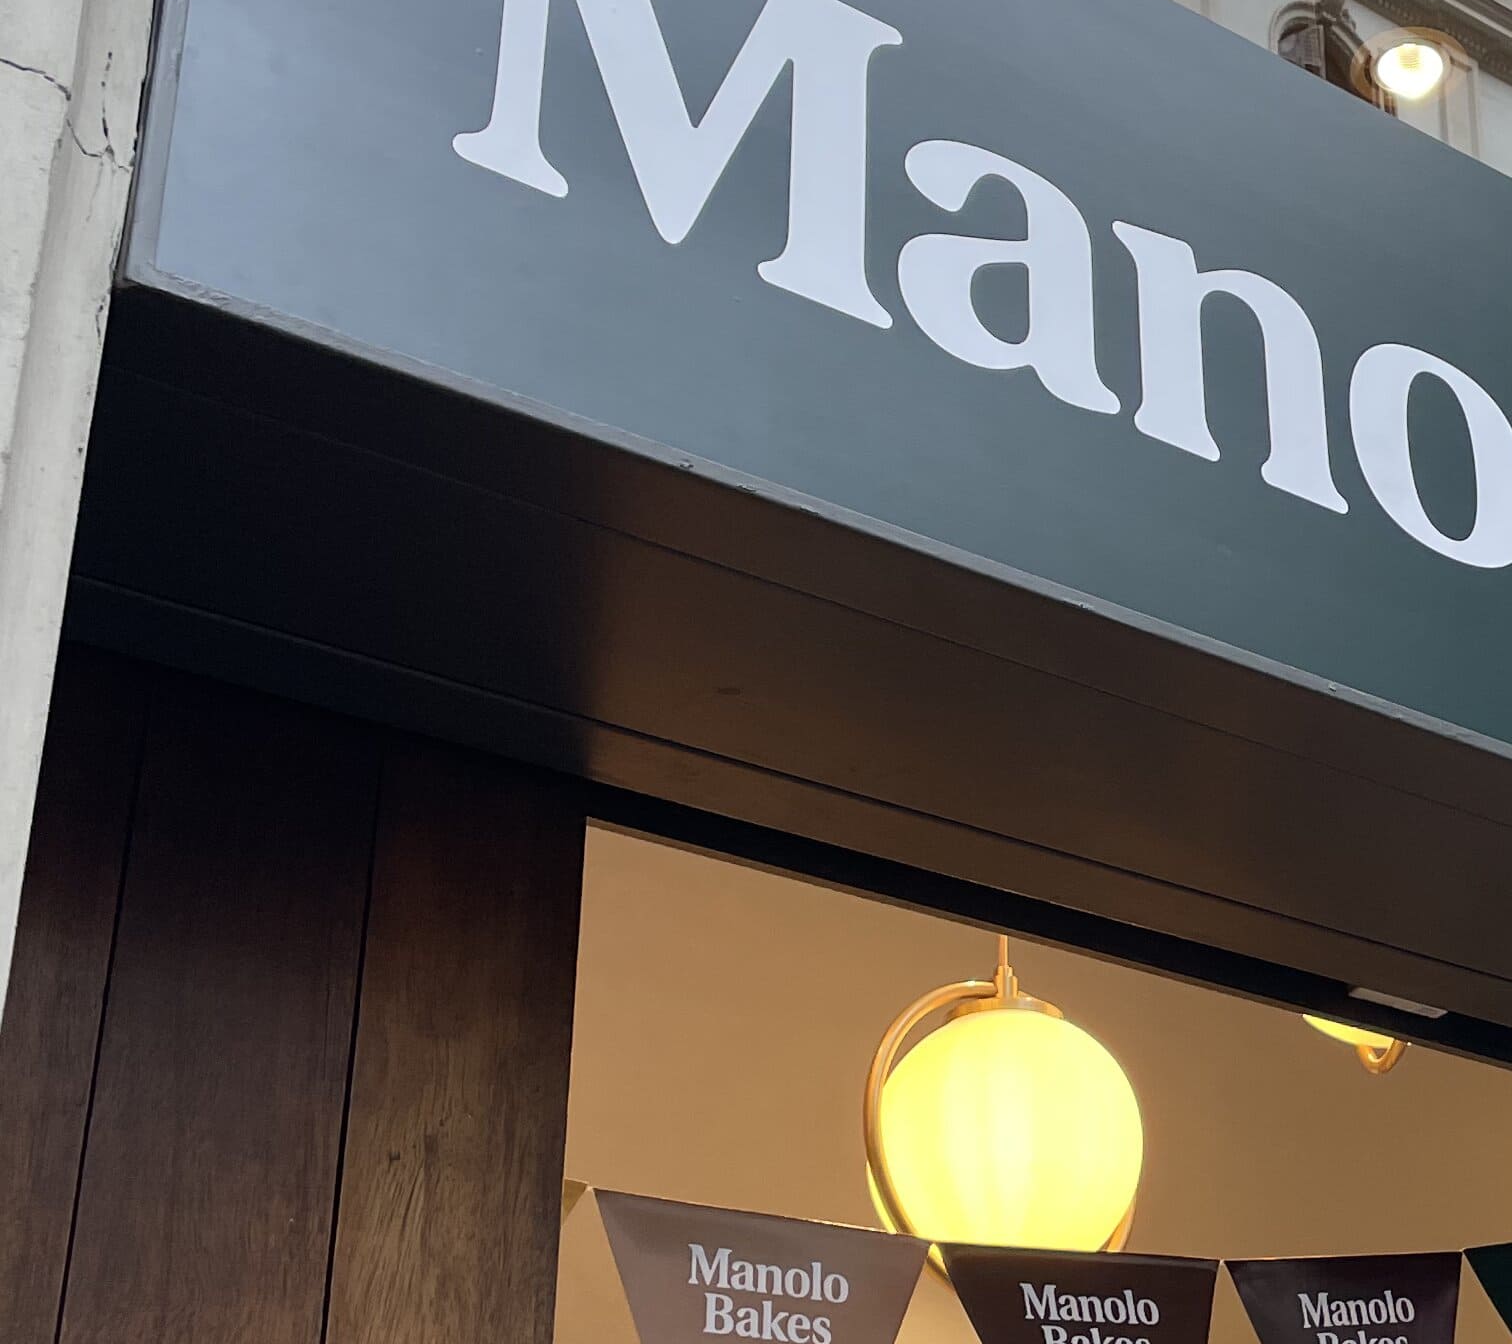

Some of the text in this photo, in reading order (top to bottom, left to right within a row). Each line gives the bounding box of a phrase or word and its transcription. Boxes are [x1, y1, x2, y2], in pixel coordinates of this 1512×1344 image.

[687, 1243, 849, 1304] Manolo
[1019, 1282, 1160, 1326] Manolo
[1297, 1289, 1416, 1329] Manolo
